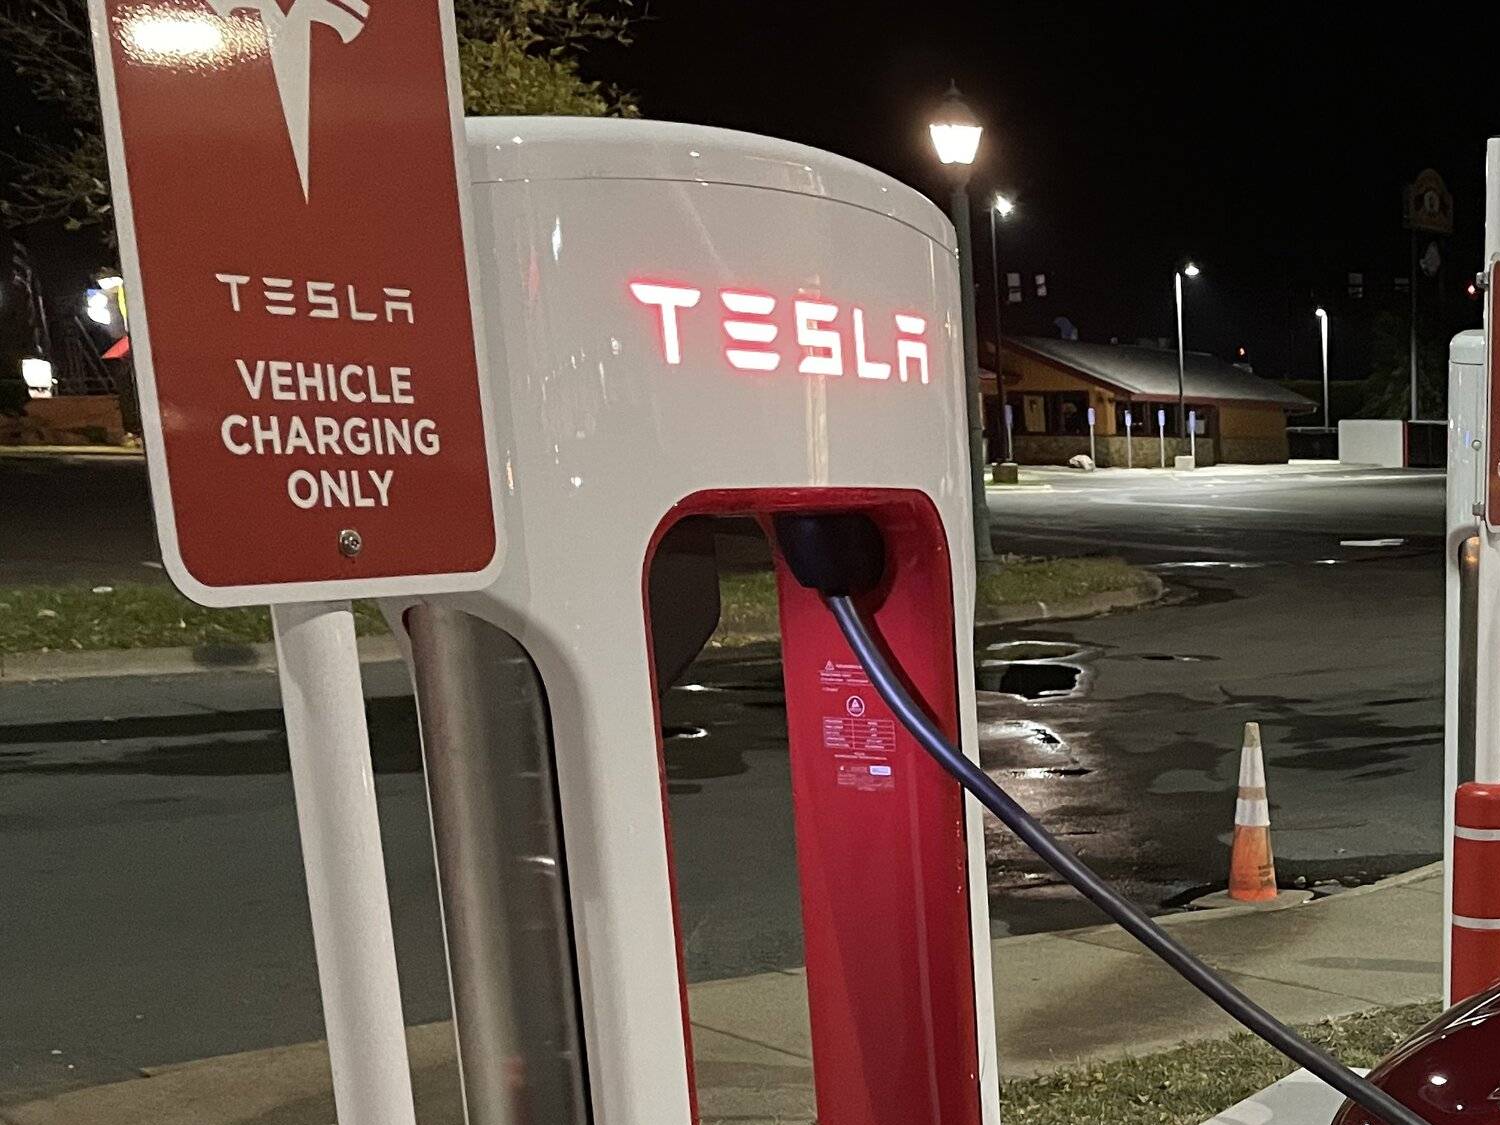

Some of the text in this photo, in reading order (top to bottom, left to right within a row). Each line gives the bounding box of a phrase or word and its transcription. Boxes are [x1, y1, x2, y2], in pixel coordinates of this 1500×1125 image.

[215, 273, 415, 324] TESLA
[629, 281, 931, 385] TESLA
[235, 358, 415, 404] VEHICLE
[221, 414, 440, 456] CHARGING
[287, 468, 394, 509] ONLY
